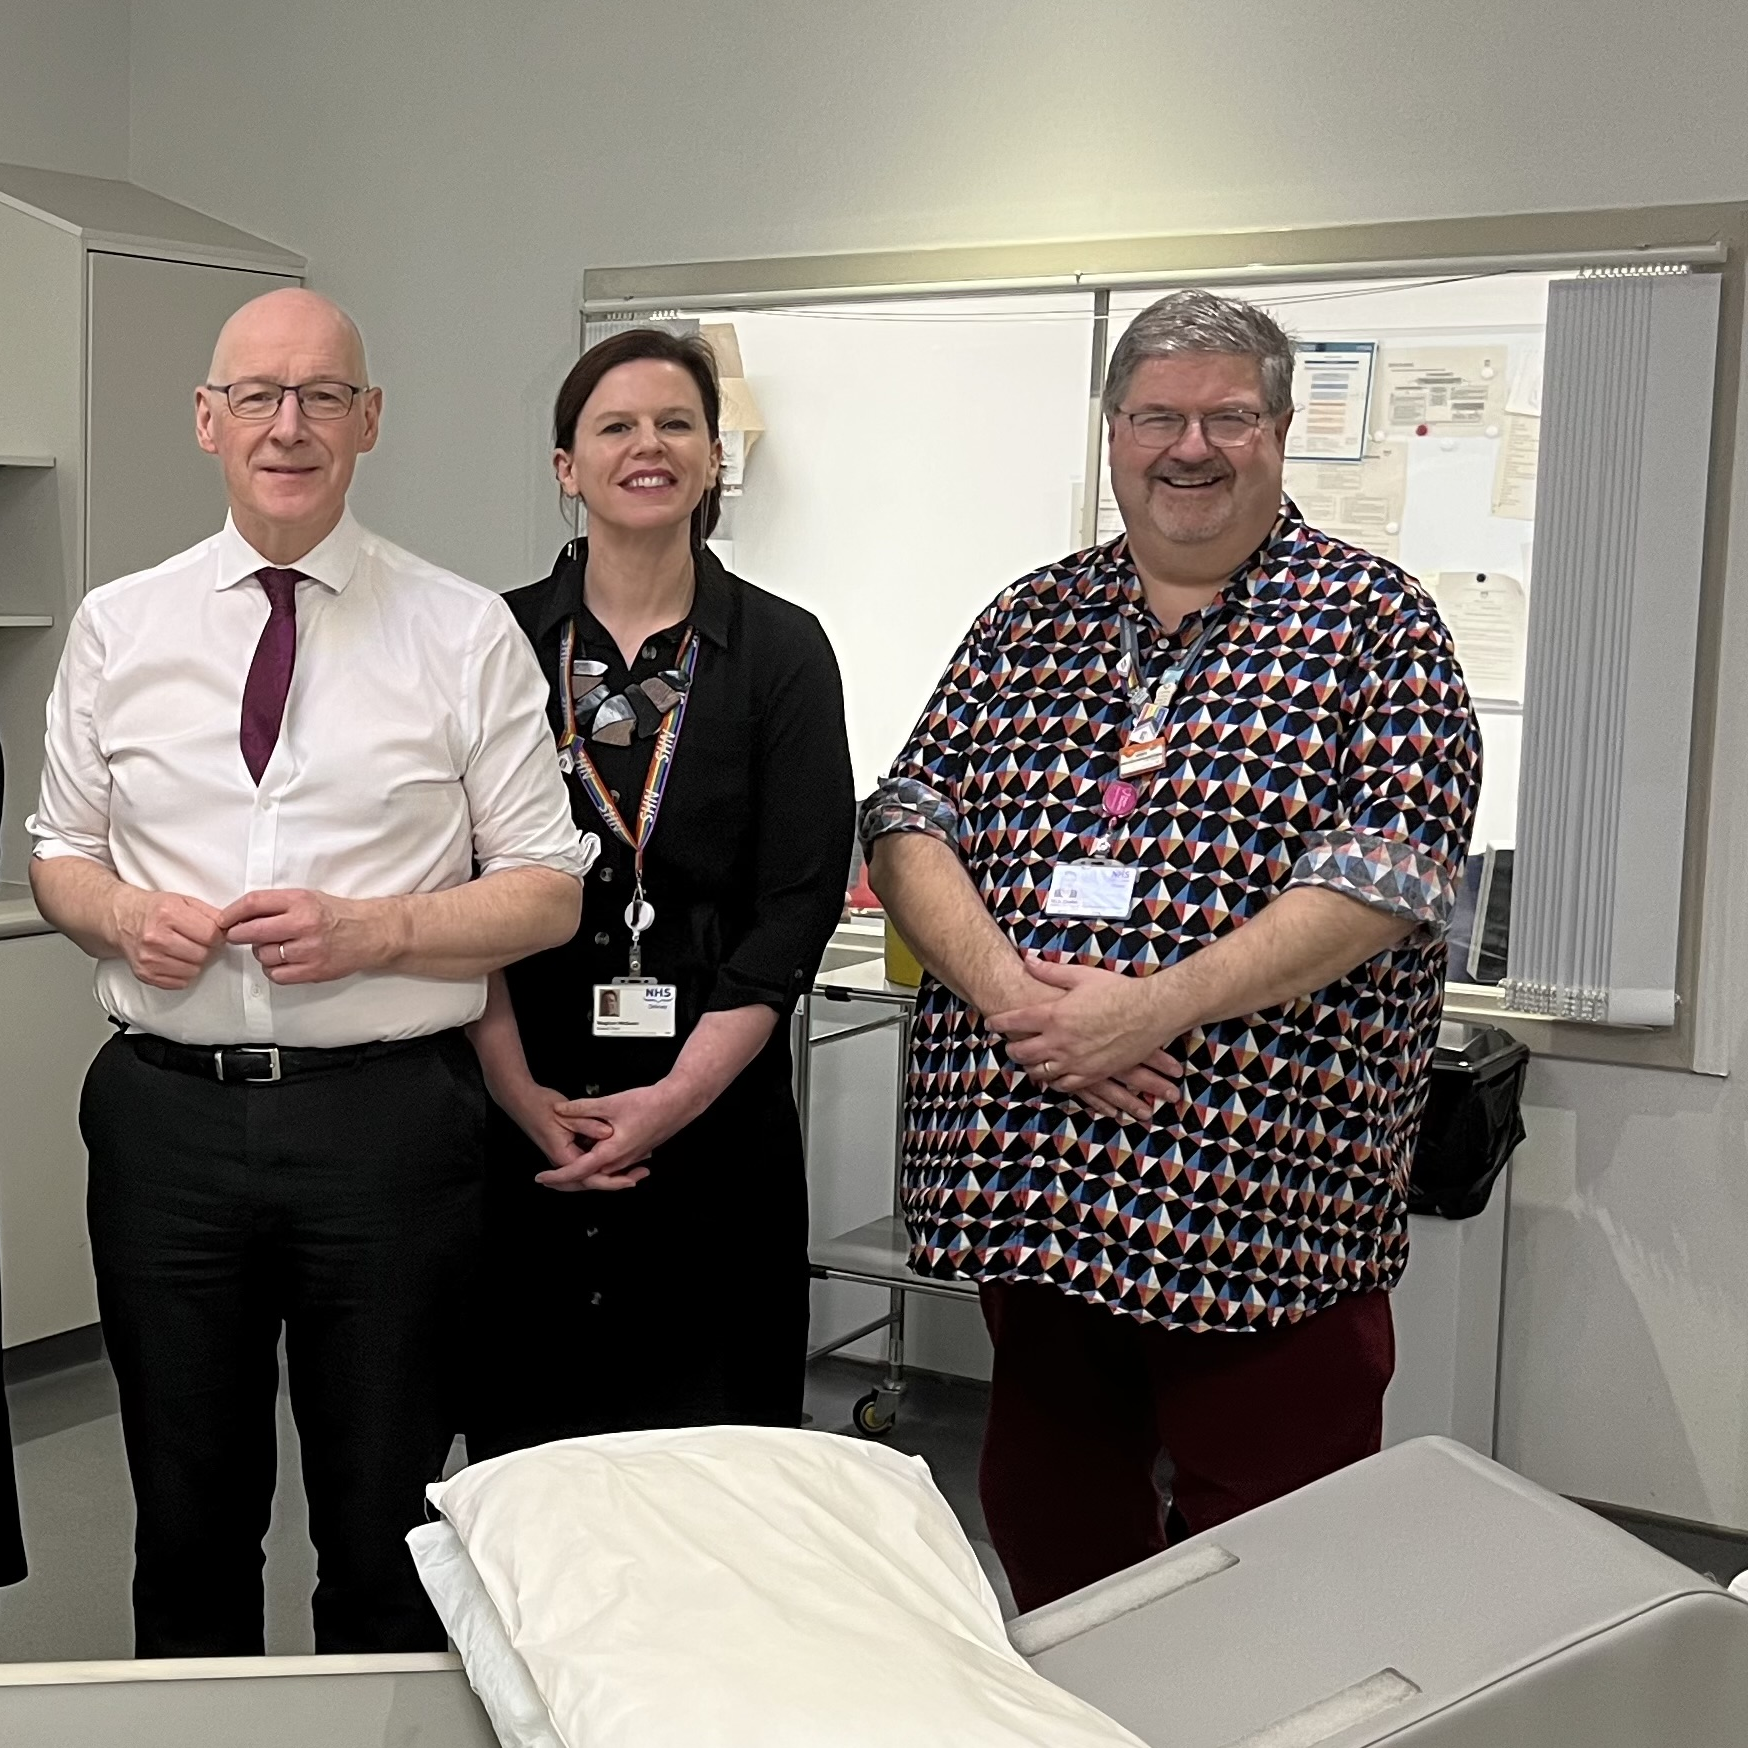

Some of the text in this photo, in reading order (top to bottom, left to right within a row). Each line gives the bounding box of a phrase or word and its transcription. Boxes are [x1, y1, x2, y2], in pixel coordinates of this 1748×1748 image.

[655, 728, 676, 764] NHS
[639, 788, 660, 823] NHS
[645, 988, 672, 998] NHS
